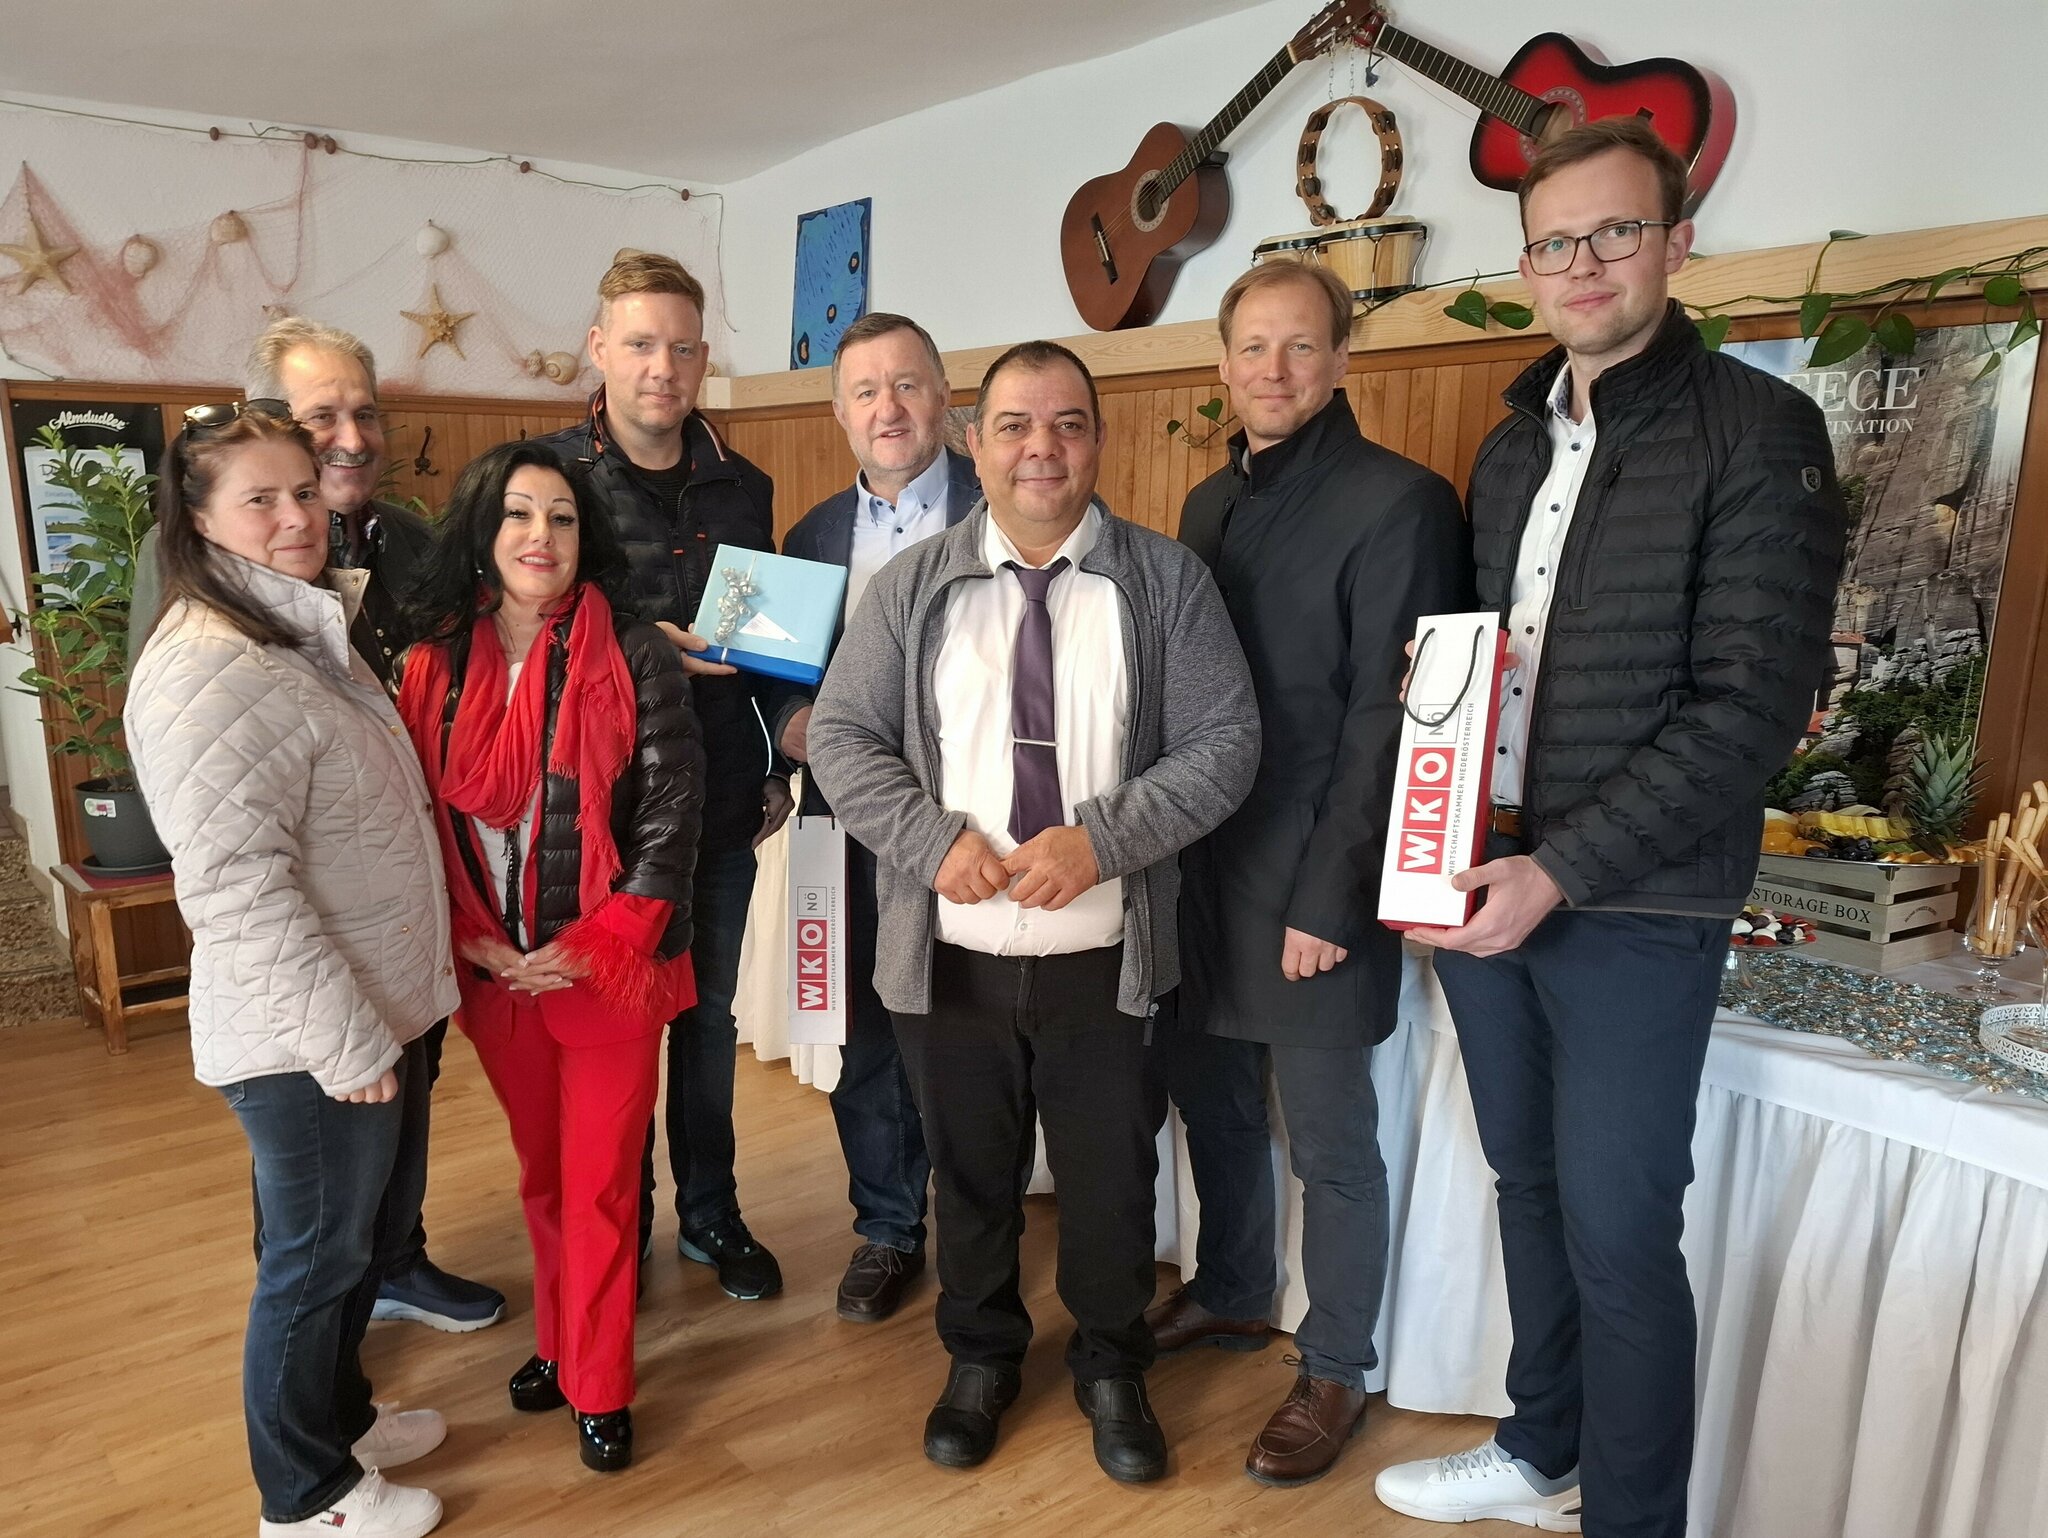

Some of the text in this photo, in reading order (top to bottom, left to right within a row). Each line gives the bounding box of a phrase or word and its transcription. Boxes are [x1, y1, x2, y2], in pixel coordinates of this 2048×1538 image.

[48, 409, 127, 430] Almdudler
[1403, 752, 1448, 870] WKO
[1448, 703, 1475, 876] WIRTSCHAFTSKAMMER NIEDERÖSTERREICH
[801, 892, 823, 1009] WKO NÖ
[1752, 887, 1872, 924] STORAGE BOX
